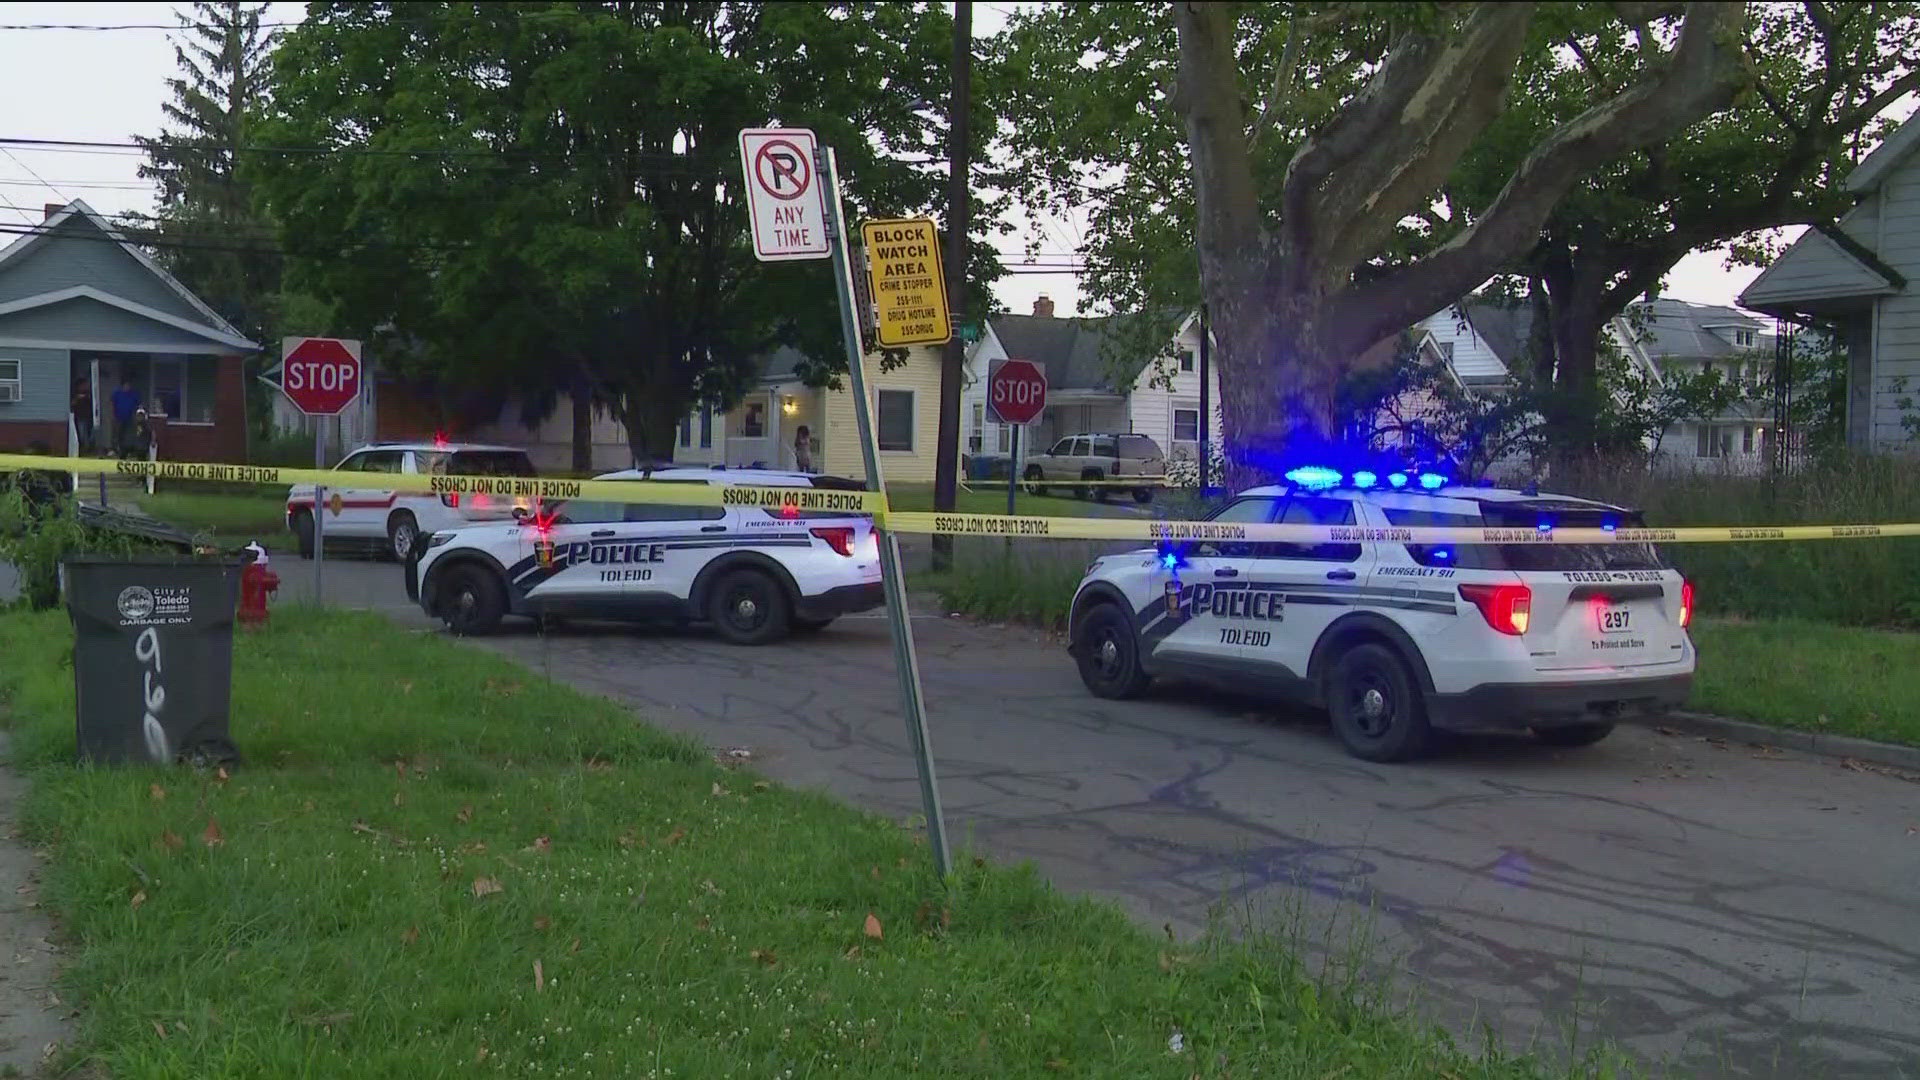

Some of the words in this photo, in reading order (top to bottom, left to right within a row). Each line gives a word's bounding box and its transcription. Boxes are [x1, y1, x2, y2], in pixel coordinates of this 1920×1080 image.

[775, 207, 804, 224] ANY
[774, 229, 811, 247] TIME
[874, 229, 925, 243] BLOCK
[877, 245, 928, 260] WATCH
[885, 262, 927, 276] AREA
[880, 281, 901, 291] CRIME
[903, 278, 933, 290] STOPPER
[888, 311, 906, 321] DRUG
[908, 308, 936, 320] HOTLINE
[288, 362, 355, 392] STOP
[995, 380, 1042, 404] STOP
[117, 461, 156, 475] CROSS
[161, 462, 184, 477] NOT
[188, 464, 204, 478] DO
[208, 465, 234, 480] LINE
[238, 467, 279, 482] POLICE
[431, 477, 467, 492] CROSS
[471, 479, 493, 494] NOT
[497, 480, 511, 494] DO
[515, 481, 538, 496] LINE
[542, 481, 580, 497] POLICE
[723, 489, 757, 505] CROSS
[760, 490, 781, 506] NOT
[784, 491, 799, 506] DO
[801, 492, 825, 508] LINE
[827, 494, 862, 510] POLICE
[935, 517, 963, 531] CROSS
[966, 518, 983, 532] NOT
[986, 519, 997, 533] DO
[1000, 519, 1018, 533] LINE
[1020, 520, 1049, 534] POLICE
[567, 541, 665, 566] POLICE
[600, 570, 652, 582] TOLEDO
[1377, 566, 1434, 577] EMERGENCY
[1437, 569, 1455, 578] 911
[1563, 572, 1612, 582] TOLEDO
[1628, 571, 1664, 581] POLICE
[153, 588, 175, 596] City
[154, 595, 190, 605] Toledo
[1191, 582, 1284, 622] POLICE
[119, 618, 166, 626] GARBAGE
[1604, 611, 1629, 628] 297
[1220, 628, 1271, 647] TOLEDO
